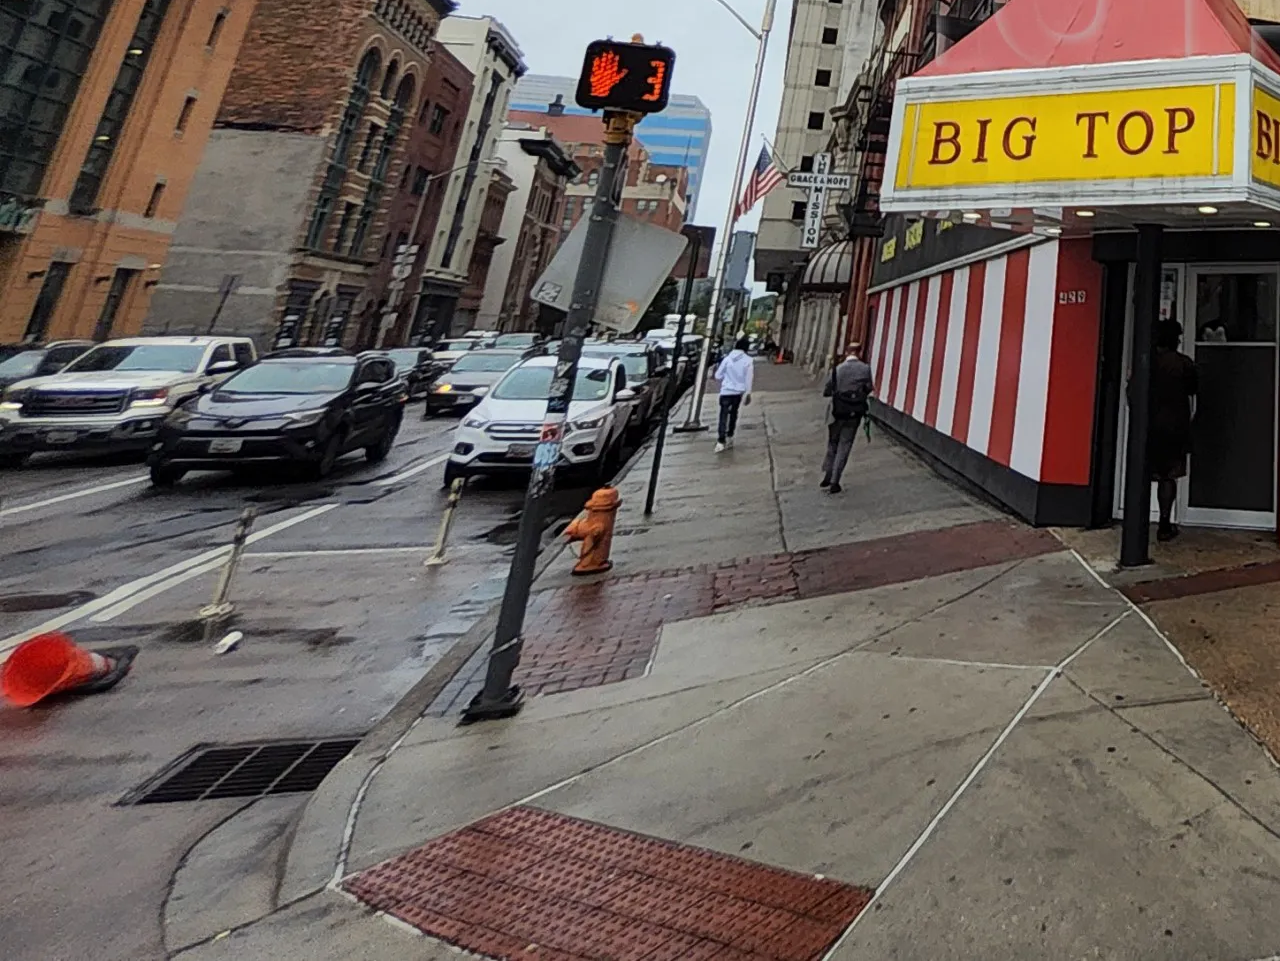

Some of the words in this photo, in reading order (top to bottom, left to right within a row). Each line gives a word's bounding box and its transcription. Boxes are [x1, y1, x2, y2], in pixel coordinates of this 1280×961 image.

[642, 60, 665, 101] 3
[927, 115, 1038, 166] BIG
[1075, 107, 1196, 159] TOP
[790, 174, 818, 185] GRACE
[826, 176, 849, 187] HOPE
[816, 153, 829, 174] THE
[805, 185, 823, 245] MISSION
